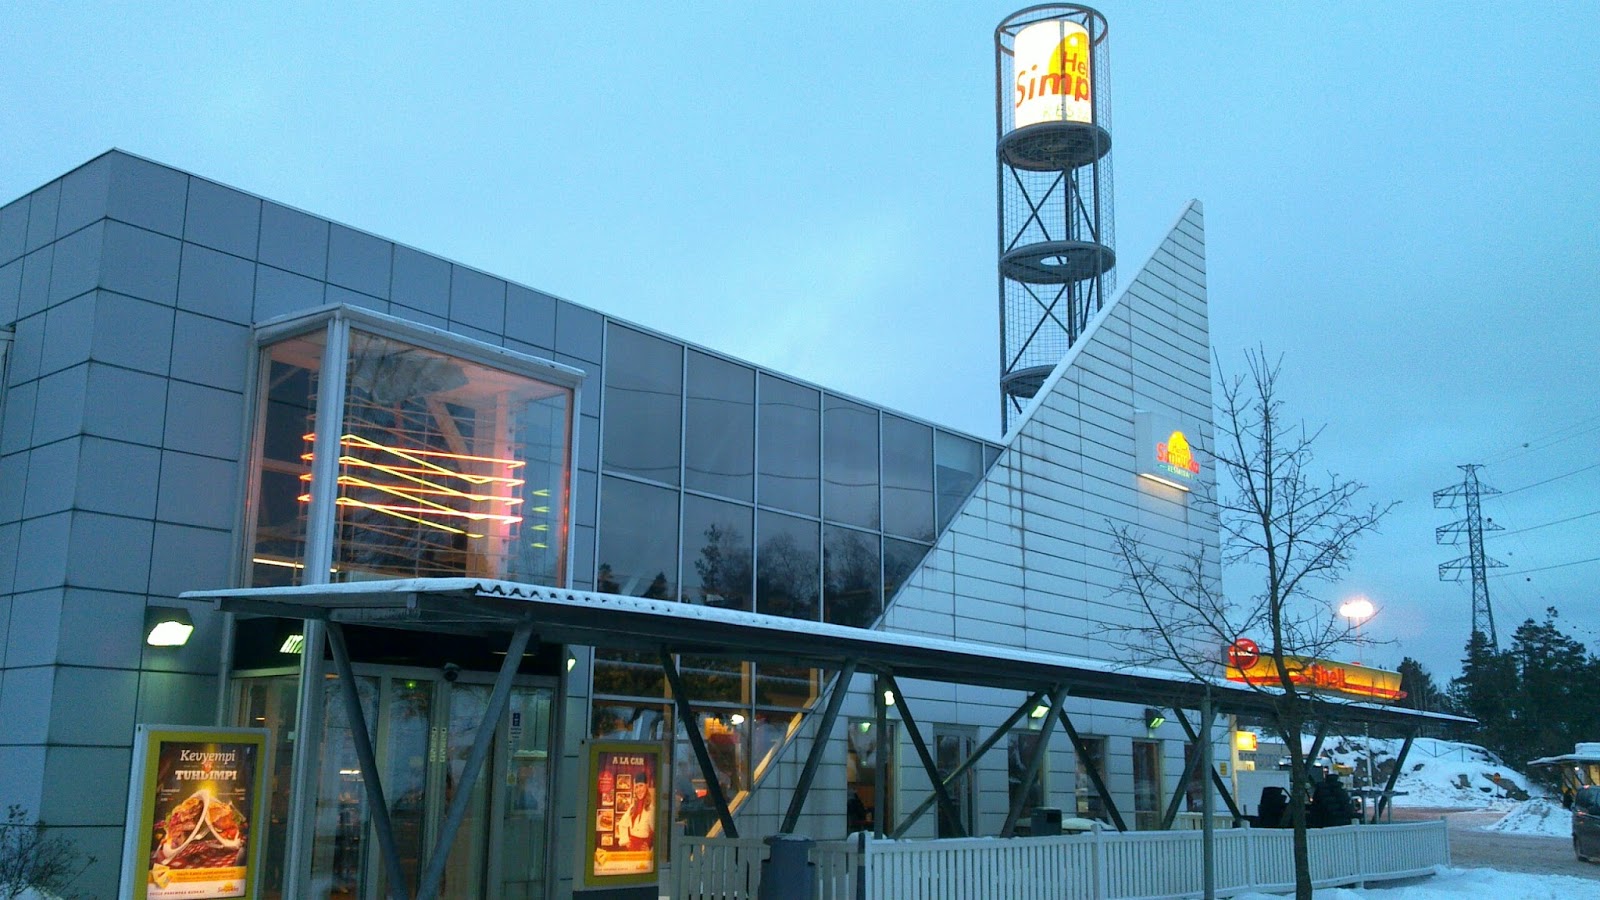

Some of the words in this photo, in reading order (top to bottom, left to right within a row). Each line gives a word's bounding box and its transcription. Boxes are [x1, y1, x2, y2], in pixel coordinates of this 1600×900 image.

[1016, 64, 1089, 108] Simp
[1312, 664, 1345, 687] Shell
[180, 750, 236, 765] Kevyempi
[612, 756, 618, 765] A
[620, 757, 629, 765] LA
[630, 757, 645, 766] CAR
